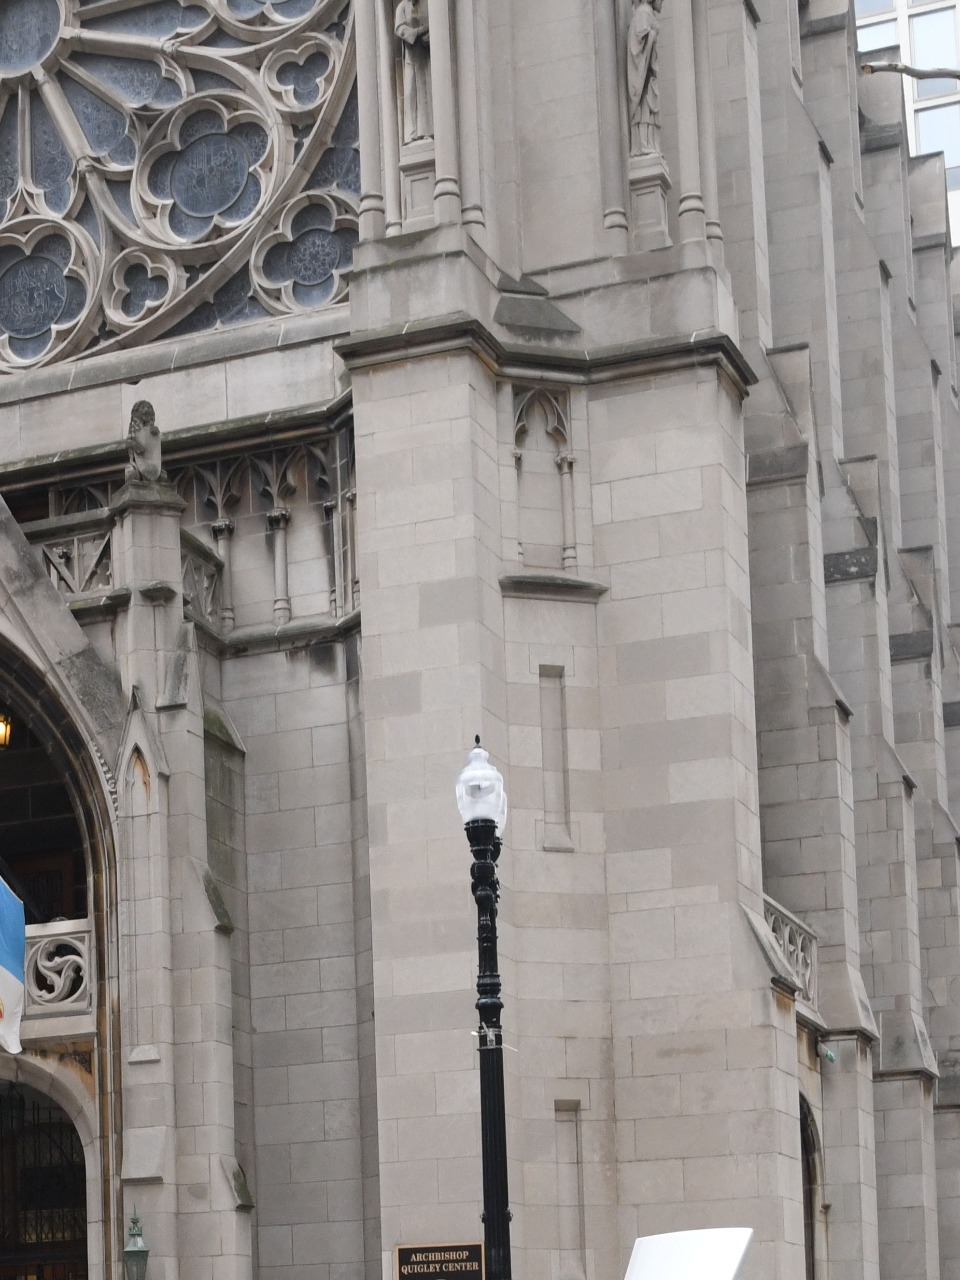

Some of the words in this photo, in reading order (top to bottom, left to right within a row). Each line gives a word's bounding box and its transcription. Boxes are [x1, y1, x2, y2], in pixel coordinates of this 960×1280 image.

[410, 1251, 469, 1262] ARCHBISHOP
[401, 1263, 441, 1275] QUIGLEY
[442, 1262, 479, 1271] CENTER
